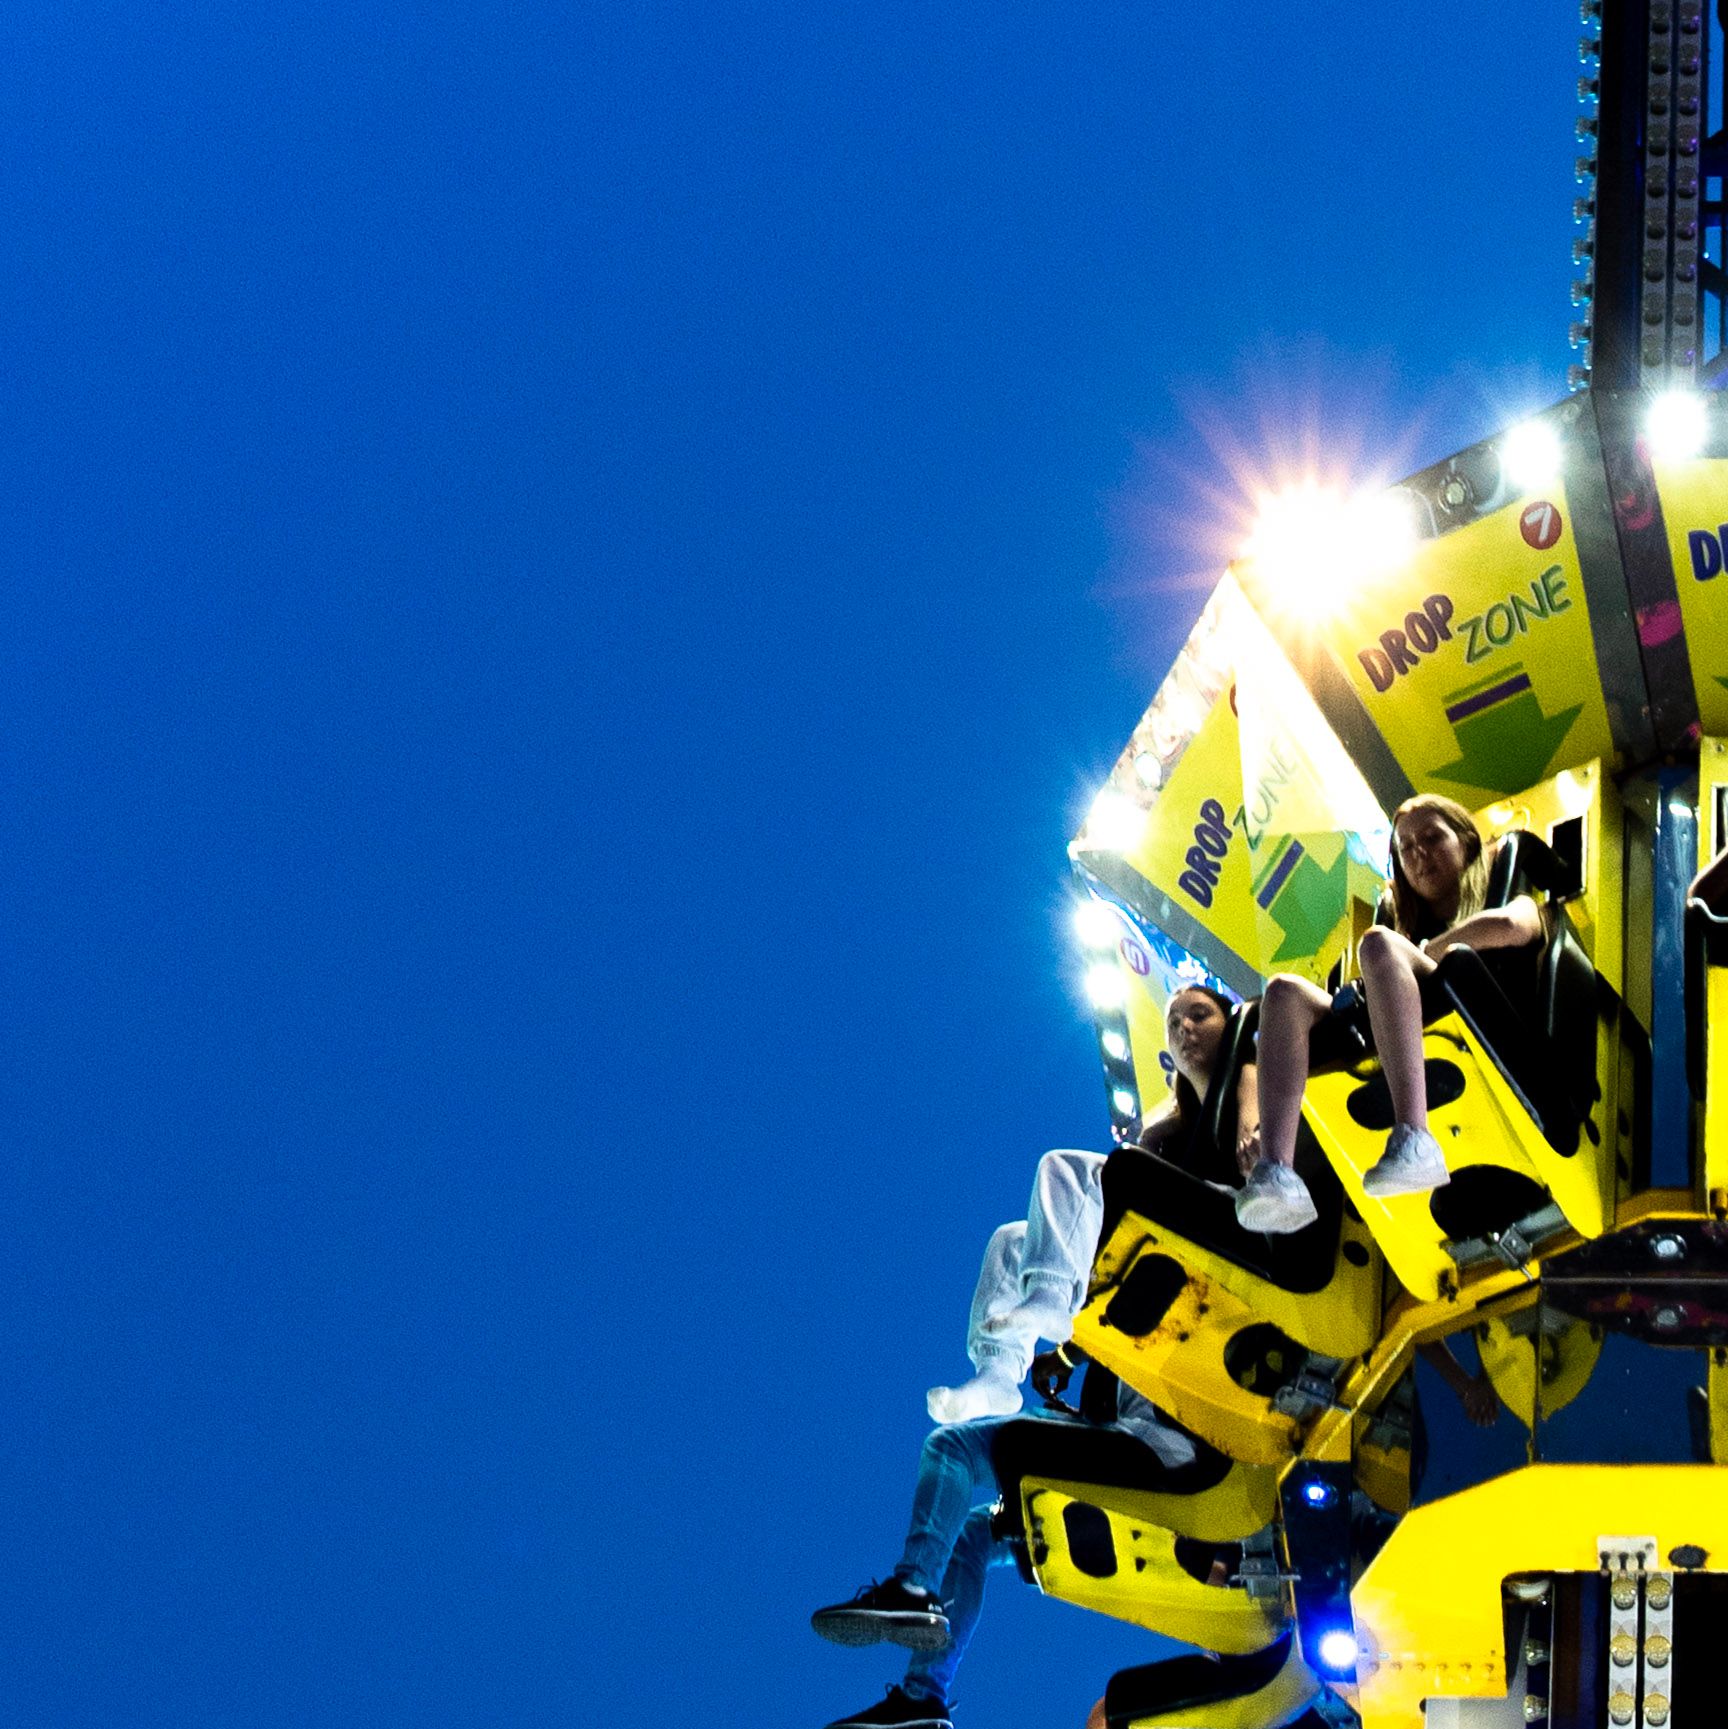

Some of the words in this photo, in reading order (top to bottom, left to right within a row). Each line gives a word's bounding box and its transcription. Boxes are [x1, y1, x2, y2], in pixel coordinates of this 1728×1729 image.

[1357, 594, 1455, 693] DROP
[1458, 563, 1573, 666] ZONE
[1178, 798, 1233, 910] DROP
